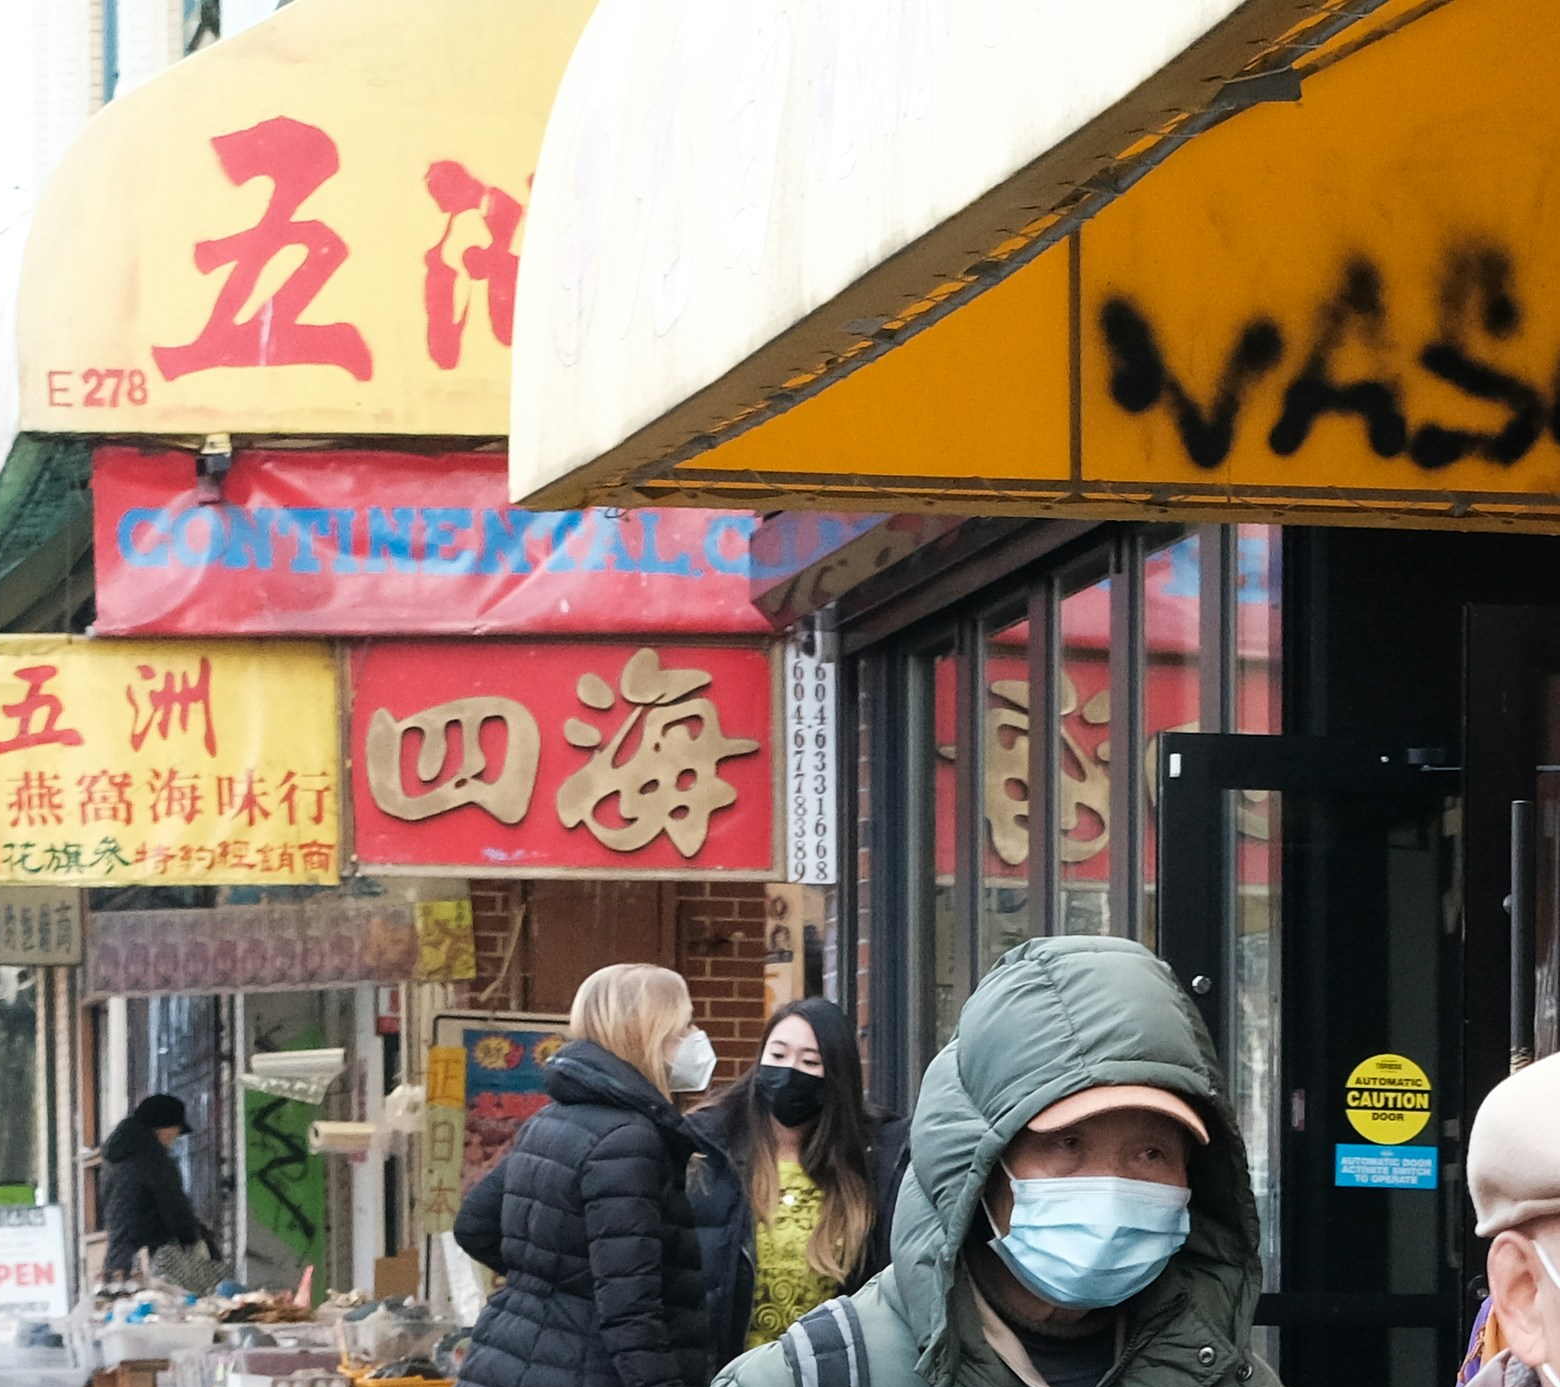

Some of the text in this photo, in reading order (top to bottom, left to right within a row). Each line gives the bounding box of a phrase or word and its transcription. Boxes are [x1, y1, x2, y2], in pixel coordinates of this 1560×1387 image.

[47, 368, 148, 409] E 278
[117, 504, 696, 578] CONTINENTAL
[365, 646, 760, 860] 四海
[1355, 1077, 1423, 1087] AUTOMATIC
[1347, 1091, 1429, 1109] CAUTION
[1372, 1112, 1404, 1121] DOOR
